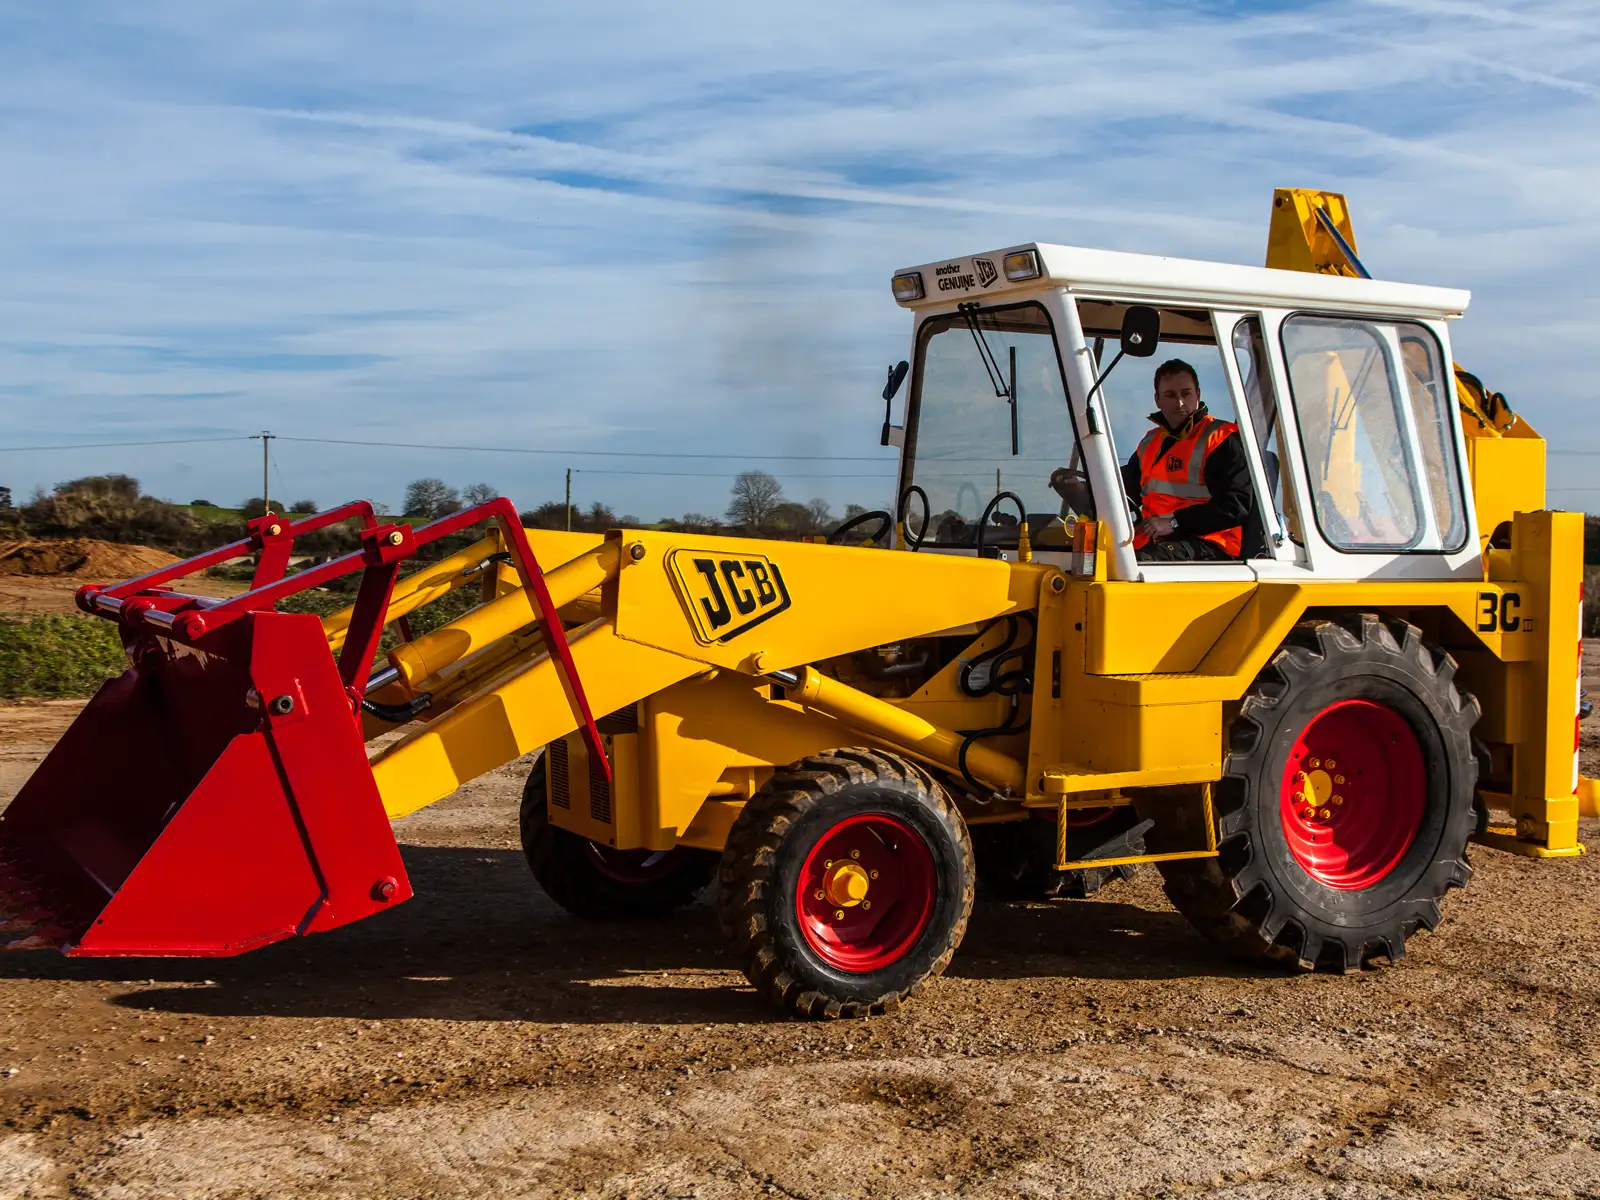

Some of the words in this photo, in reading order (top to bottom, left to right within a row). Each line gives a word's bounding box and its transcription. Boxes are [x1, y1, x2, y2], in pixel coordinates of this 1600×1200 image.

[935, 263, 961, 276] another
[976, 260, 995, 283] JCB
[937, 274, 976, 291] GENUINE
[1168, 455, 1184, 470] JCB
[692, 558, 777, 631] JCB
[1478, 592, 1521, 632] 3C
